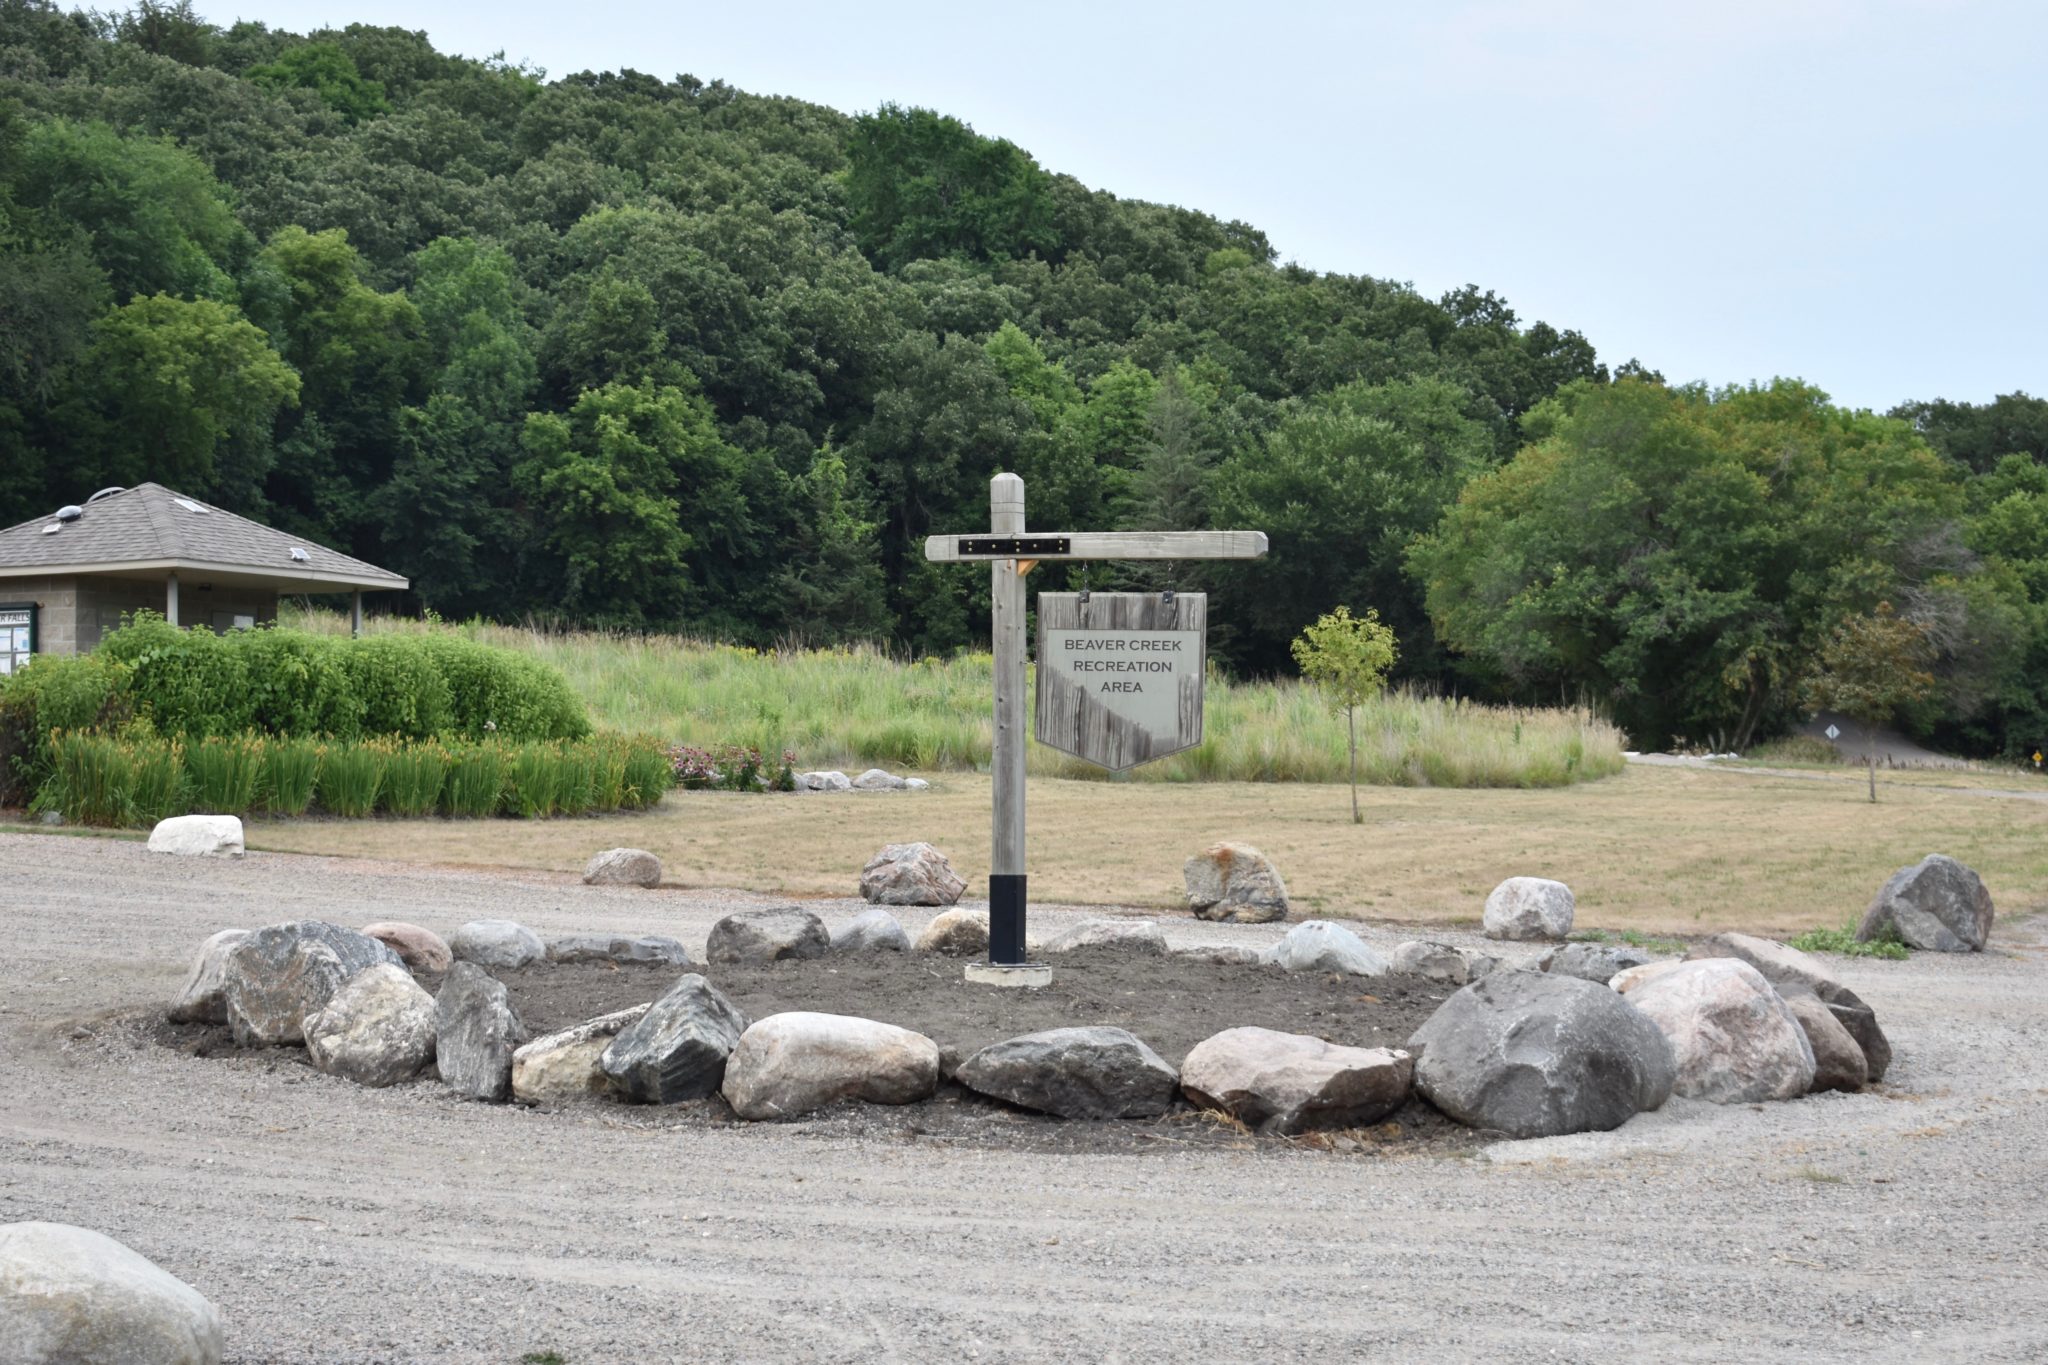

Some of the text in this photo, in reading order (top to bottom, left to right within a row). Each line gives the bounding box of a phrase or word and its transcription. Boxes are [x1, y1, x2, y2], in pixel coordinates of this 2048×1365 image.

[1064, 639, 1182, 651] BEAVER CREEK
[1073, 660, 1172, 672] RECREATION
[1101, 682, 1143, 693] AREA
